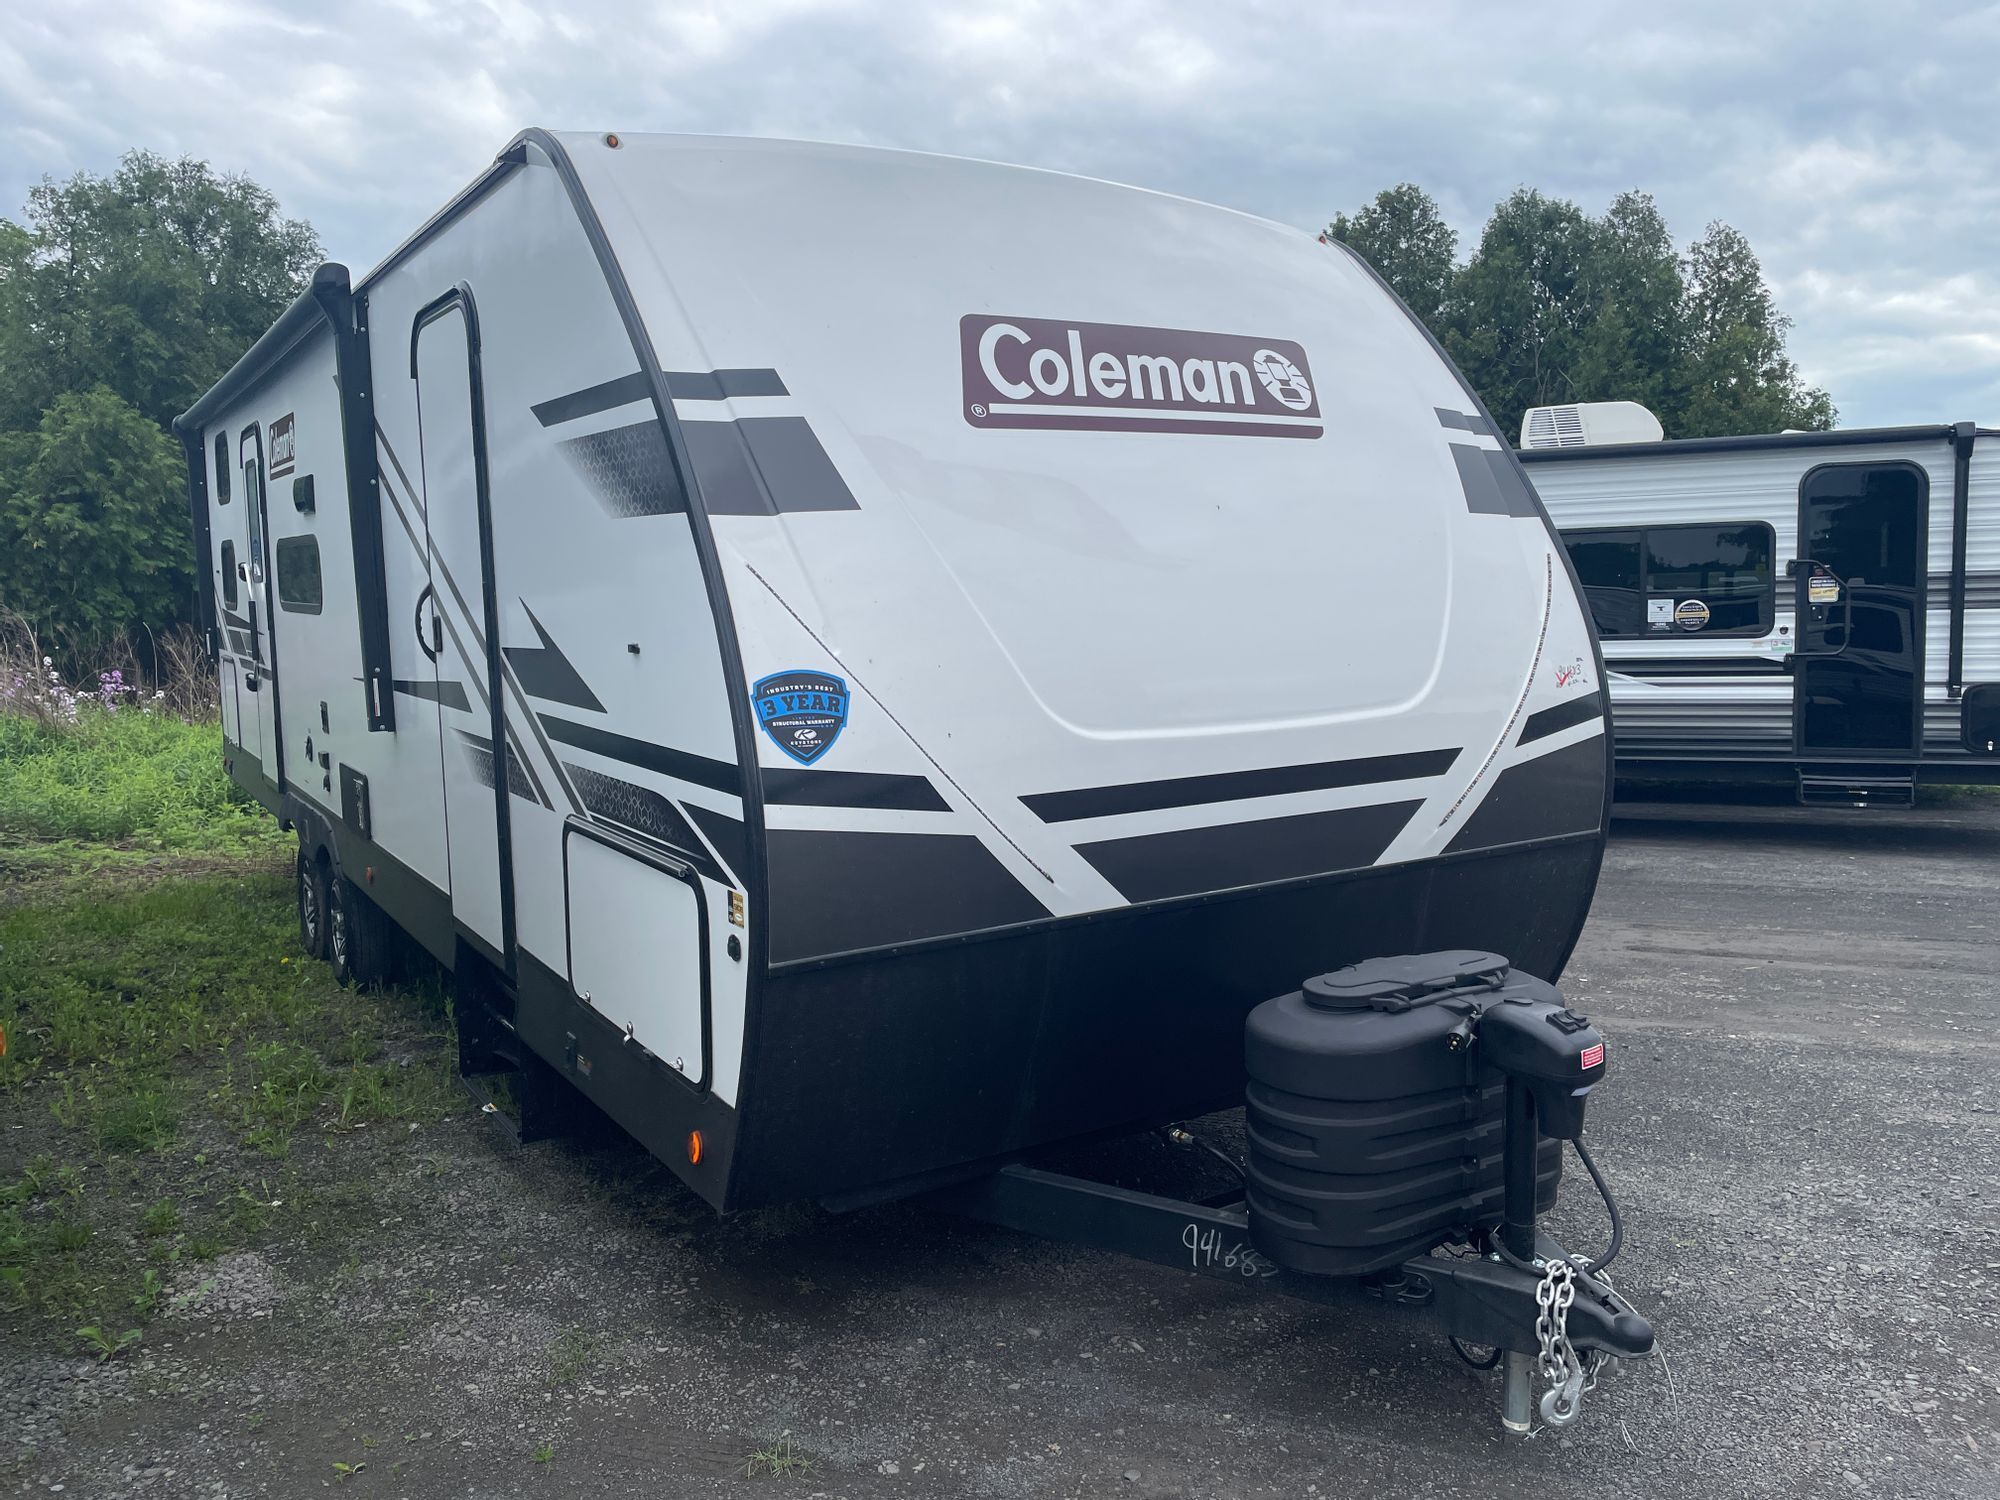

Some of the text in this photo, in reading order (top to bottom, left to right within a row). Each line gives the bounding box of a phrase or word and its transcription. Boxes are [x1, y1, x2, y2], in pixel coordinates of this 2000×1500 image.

[978, 322, 1256, 406] Coleman
[766, 685, 834, 695] INDUSTRY'S BEST
[763, 694, 840, 717] 3 YEAR
[806, 718, 835, 726] WARRANTY
